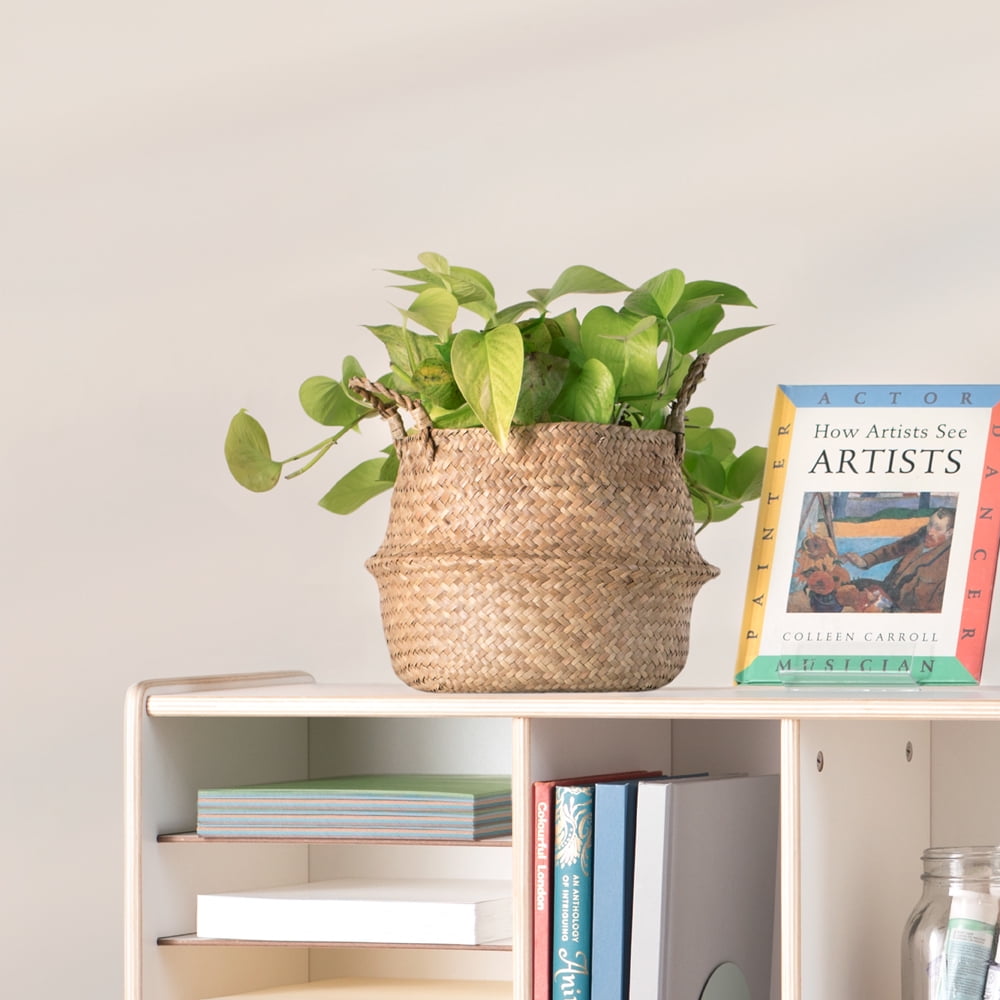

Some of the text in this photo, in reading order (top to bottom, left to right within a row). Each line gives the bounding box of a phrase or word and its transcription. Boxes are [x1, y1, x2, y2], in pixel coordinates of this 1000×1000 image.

[817, 391, 974, 405] ACTOR
[814, 423, 968, 439] How Artists See
[808, 448, 963, 475] ARTISTS
[746, 422, 791, 640] PAINTER
[782, 631, 939, 642] COLLEEN CARROLL
[776, 658, 935, 672] MUSICIAN
[537, 801, 547, 911] Colourful London
[561, 874, 570, 942] OF INTRIGUING
[571, 874, 580, 943] AN ANTHOLOGY
